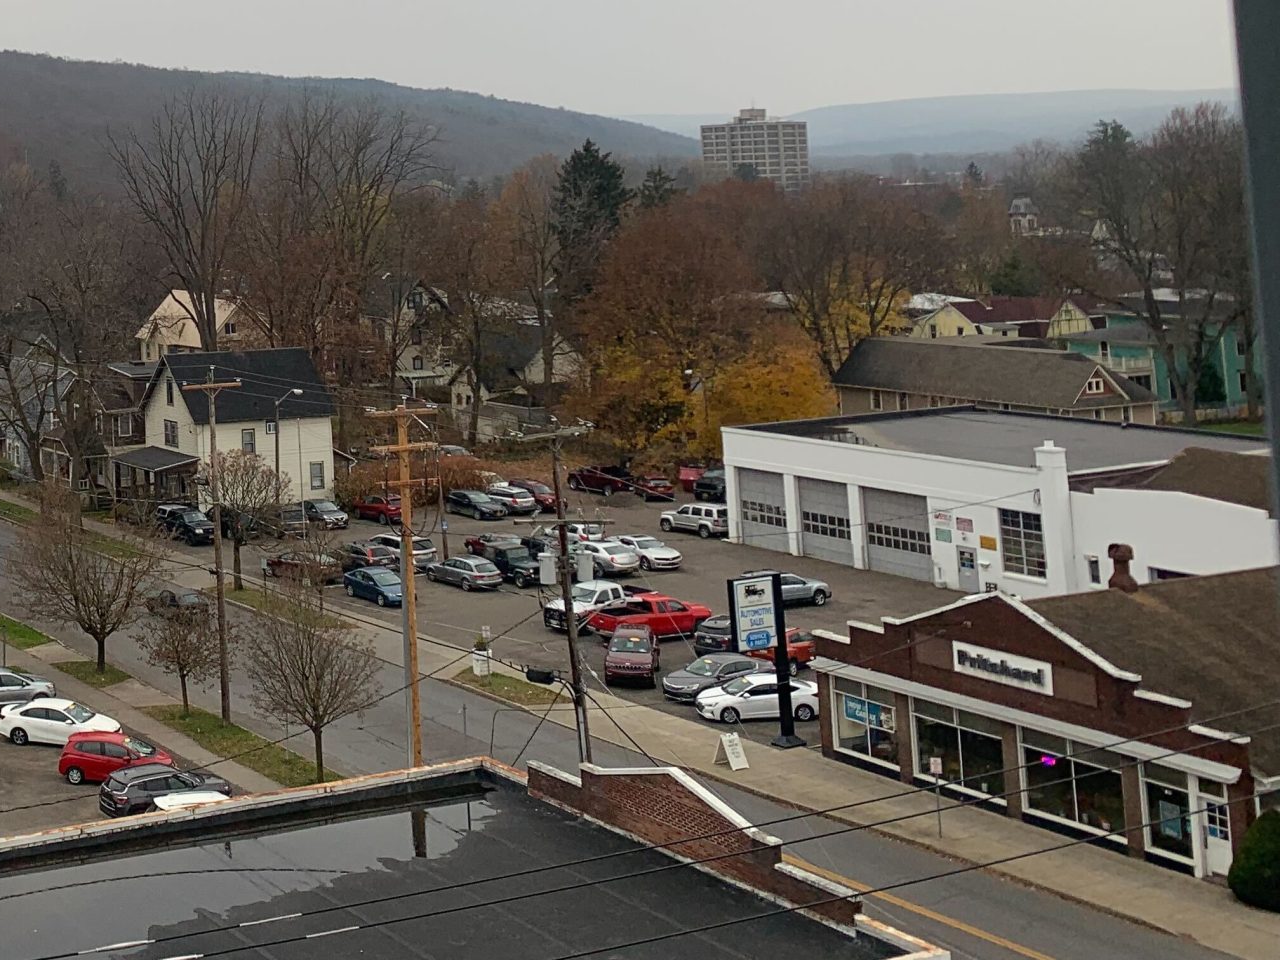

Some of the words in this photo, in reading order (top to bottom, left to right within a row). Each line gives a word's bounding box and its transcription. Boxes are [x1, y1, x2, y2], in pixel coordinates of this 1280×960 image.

[740, 607, 773, 618] AUTOMOTIVE
[750, 618, 764, 627] SALES
[957, 649, 1045, 686] Pritchard
